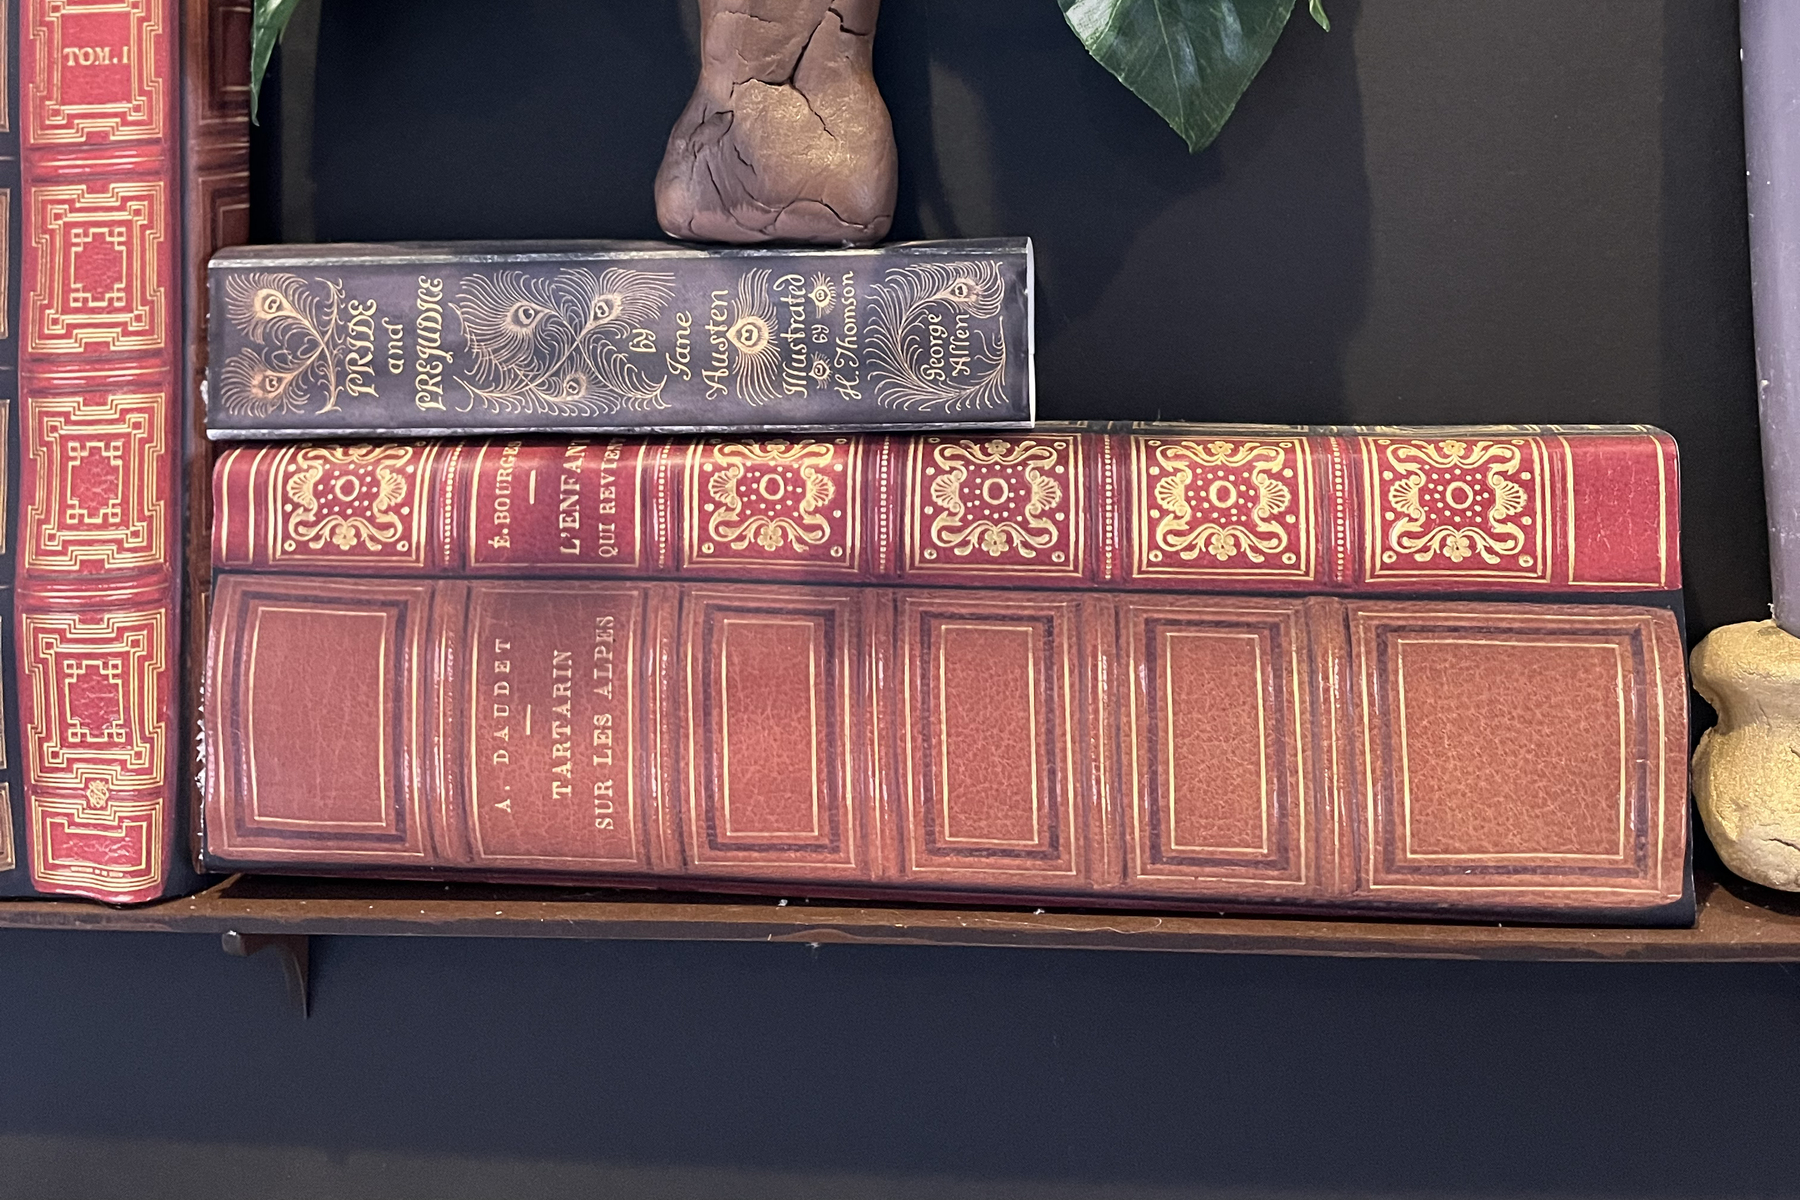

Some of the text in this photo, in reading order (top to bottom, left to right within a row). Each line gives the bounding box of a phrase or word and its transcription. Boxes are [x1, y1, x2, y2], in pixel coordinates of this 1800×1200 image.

[63, 46, 118, 66] TOM.
[345, 299, 379, 398] PRIDE
[381, 316, 405, 375] and
[415, 275, 454, 412] PREJUDICE
[628, 328, 657, 353] by
[666, 310, 692, 381] Jane
[701, 289, 730, 401] Austen
[773, 273, 808, 399] Illustrated
[811, 324, 830, 344] by
[920, 313, 948, 381] George
[949, 314, 971, 377] Allen
[598, 523, 619, 558] QUI
[493, 638, 511, 813] A. DAUDET
[552, 650, 572, 800] TARTARIN
[593, 615, 615, 830] SUR LES ALPES
